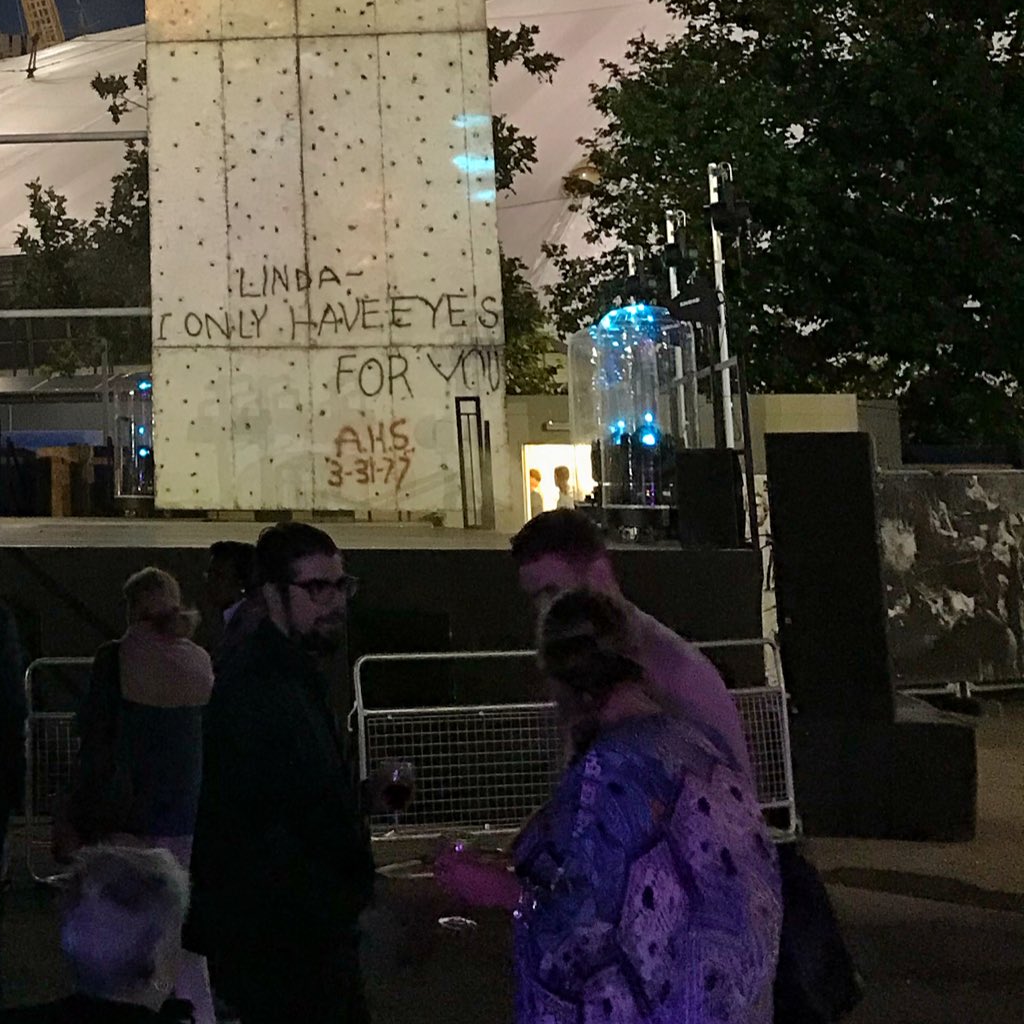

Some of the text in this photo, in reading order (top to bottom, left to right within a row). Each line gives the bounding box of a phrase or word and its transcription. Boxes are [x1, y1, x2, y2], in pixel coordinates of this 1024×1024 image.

[157, 293, 499, 341] I ONLY HAVE EYES
[335, 354, 414, 398] FOR
[327, 456, 410, 491] 3-31-77
